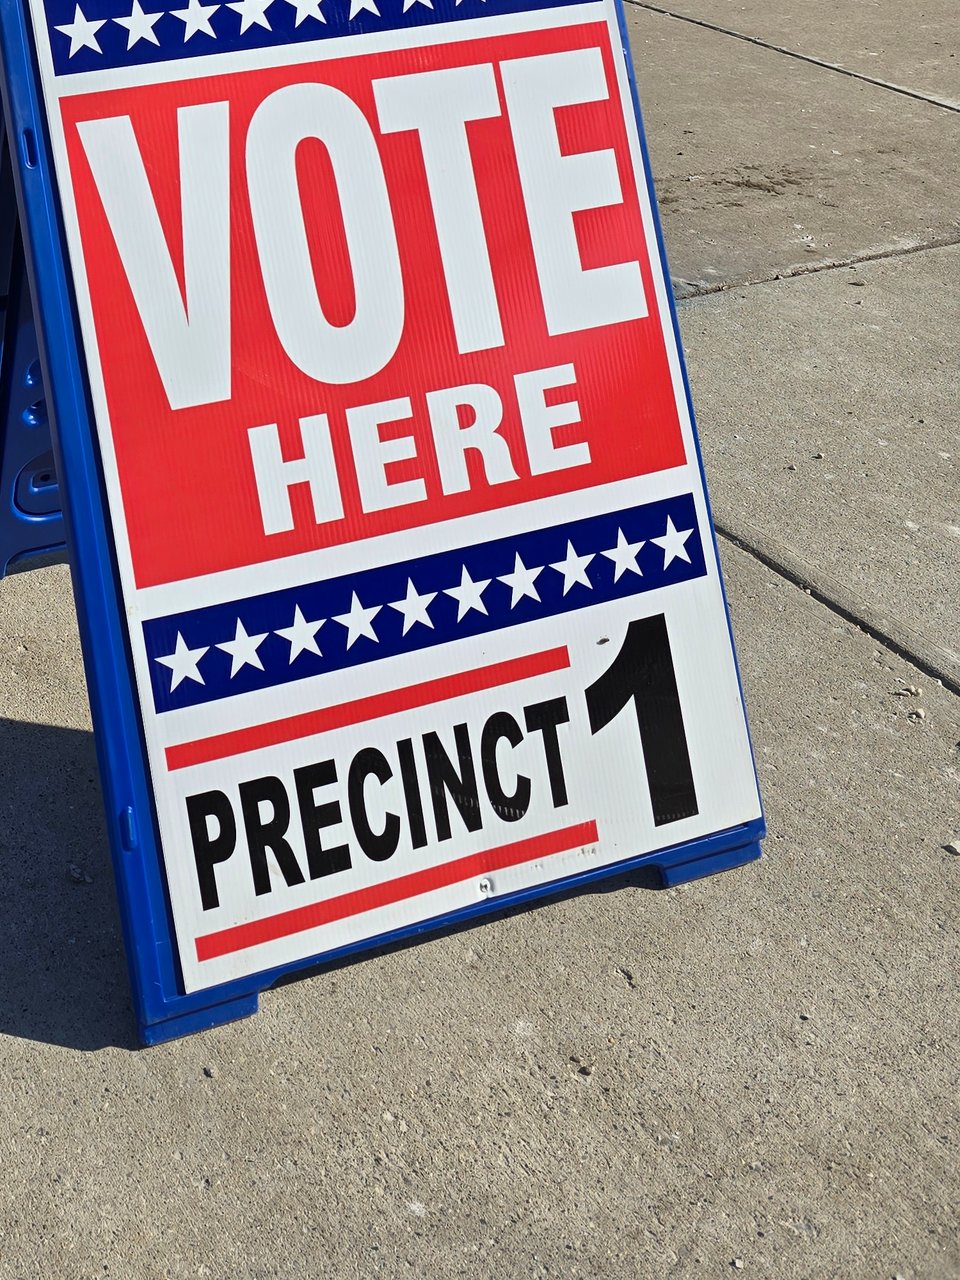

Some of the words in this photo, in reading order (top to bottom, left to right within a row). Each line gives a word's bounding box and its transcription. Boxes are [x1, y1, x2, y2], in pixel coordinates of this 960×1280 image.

[75, 46, 650, 412] VOTE
[247, 362, 592, 537] HERE
[185, 695, 571, 911] PRECINCT
[585, 612, 700, 827] 1
